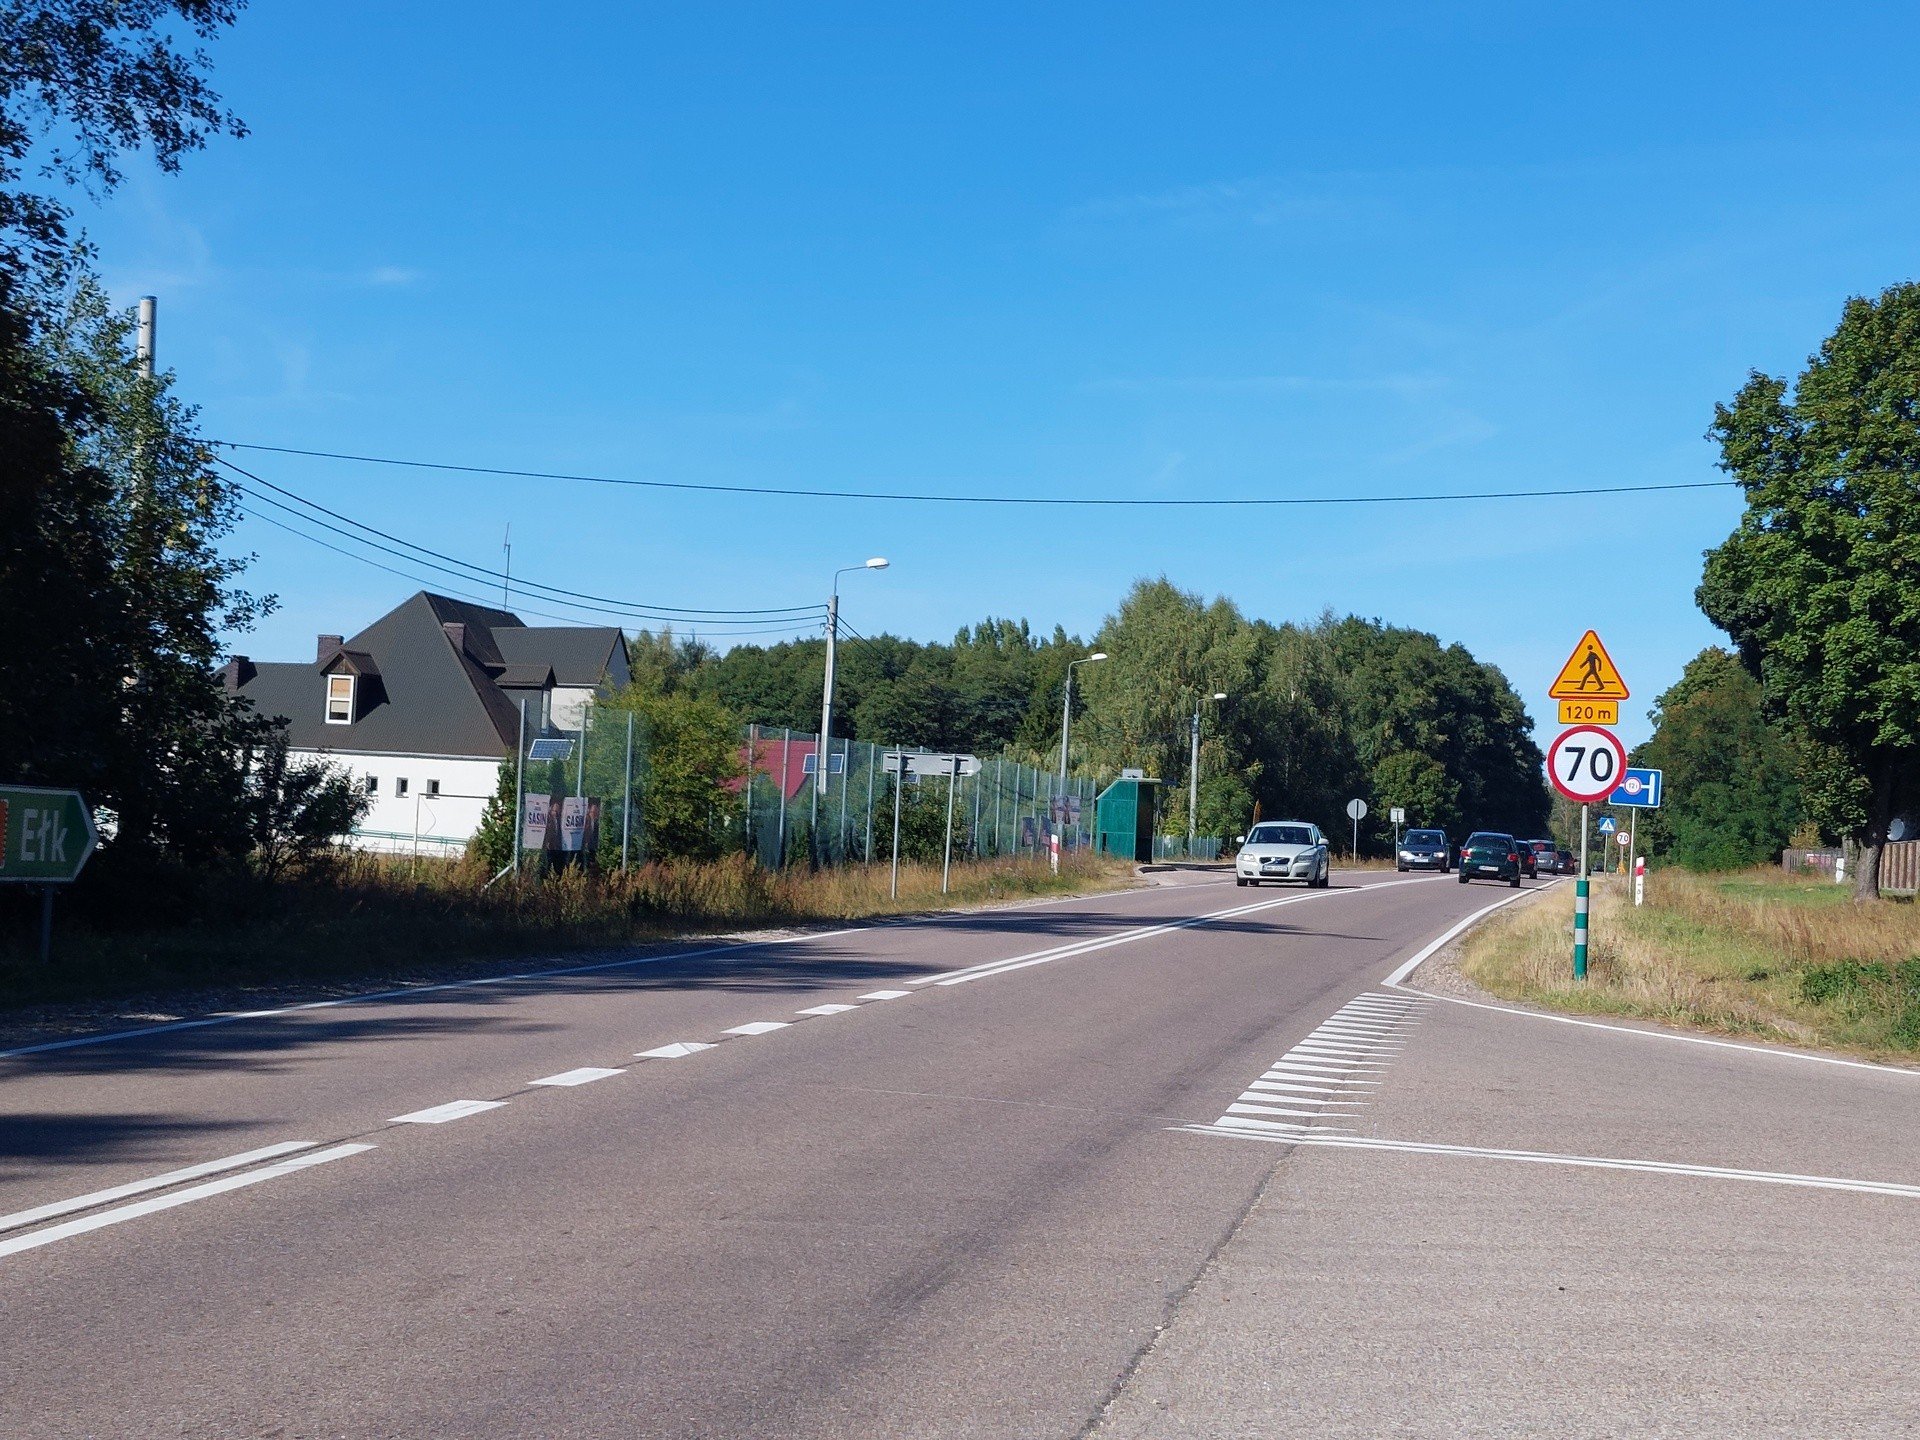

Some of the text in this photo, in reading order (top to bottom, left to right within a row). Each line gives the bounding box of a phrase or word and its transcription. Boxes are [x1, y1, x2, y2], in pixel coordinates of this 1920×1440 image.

[1566, 705, 1611, 719] 120 m
[1564, 746, 1614, 782] 70
[528, 812, 547, 825] SASIN
[20, 808, 69, 862] Ełk
[1618, 834, 1629, 842] 70
